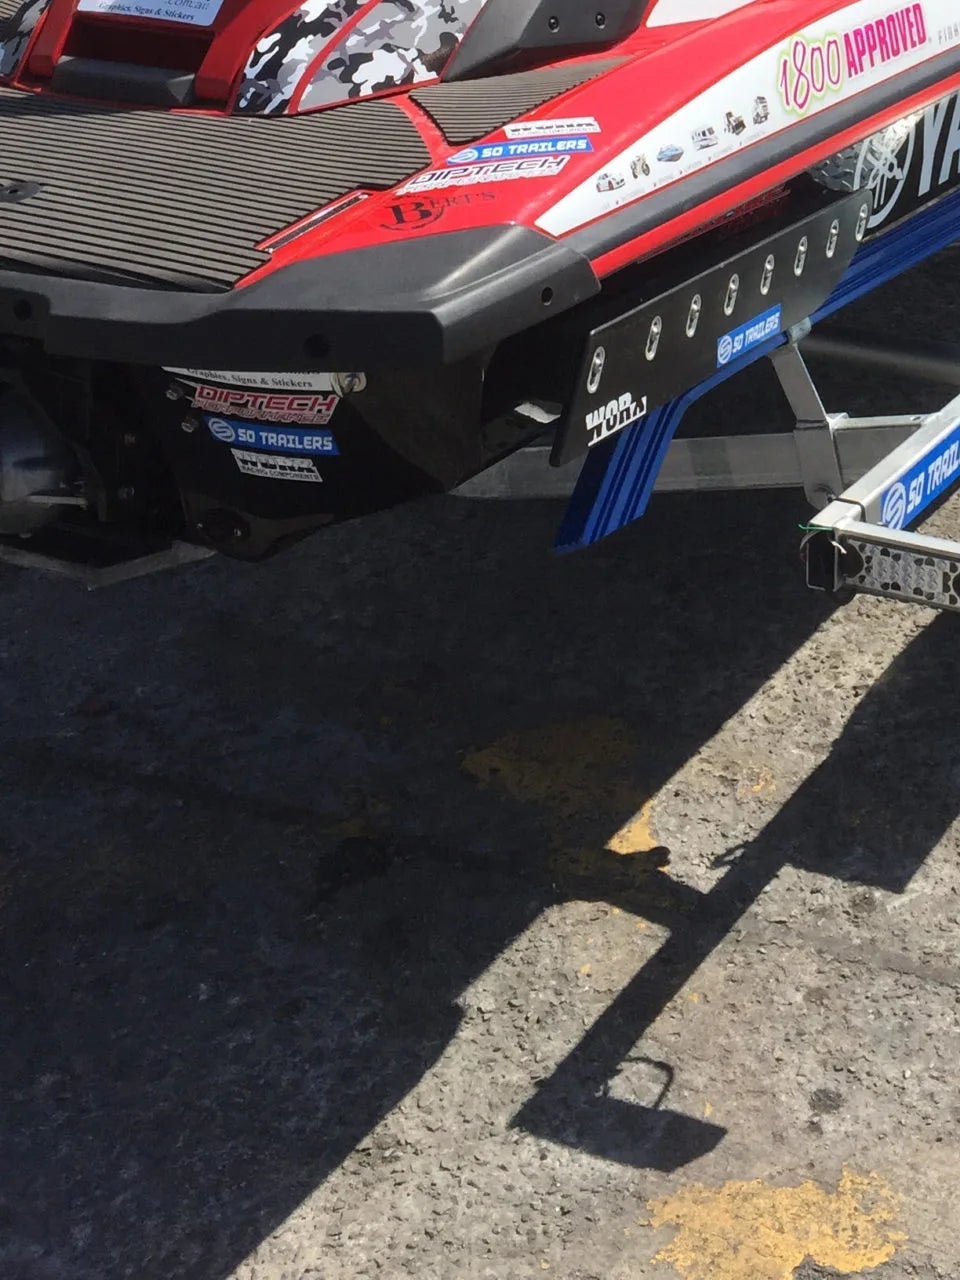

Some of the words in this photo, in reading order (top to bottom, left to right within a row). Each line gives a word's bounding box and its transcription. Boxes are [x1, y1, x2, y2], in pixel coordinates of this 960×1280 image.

[154, 7, 163, 16] &
[164, 8, 195, 21] Stickers
[779, 39, 842, 110] 1800
[843, 1, 929, 79] APPROVED
[508, 138, 588, 155] TRAILERS
[231, 375, 258, 386] Signs
[259, 376, 270, 386] &
[271, 378, 314, 388] Stickers
[197, 385, 337, 412] DIPTECH
[259, 431, 333, 451] TRAILERS
